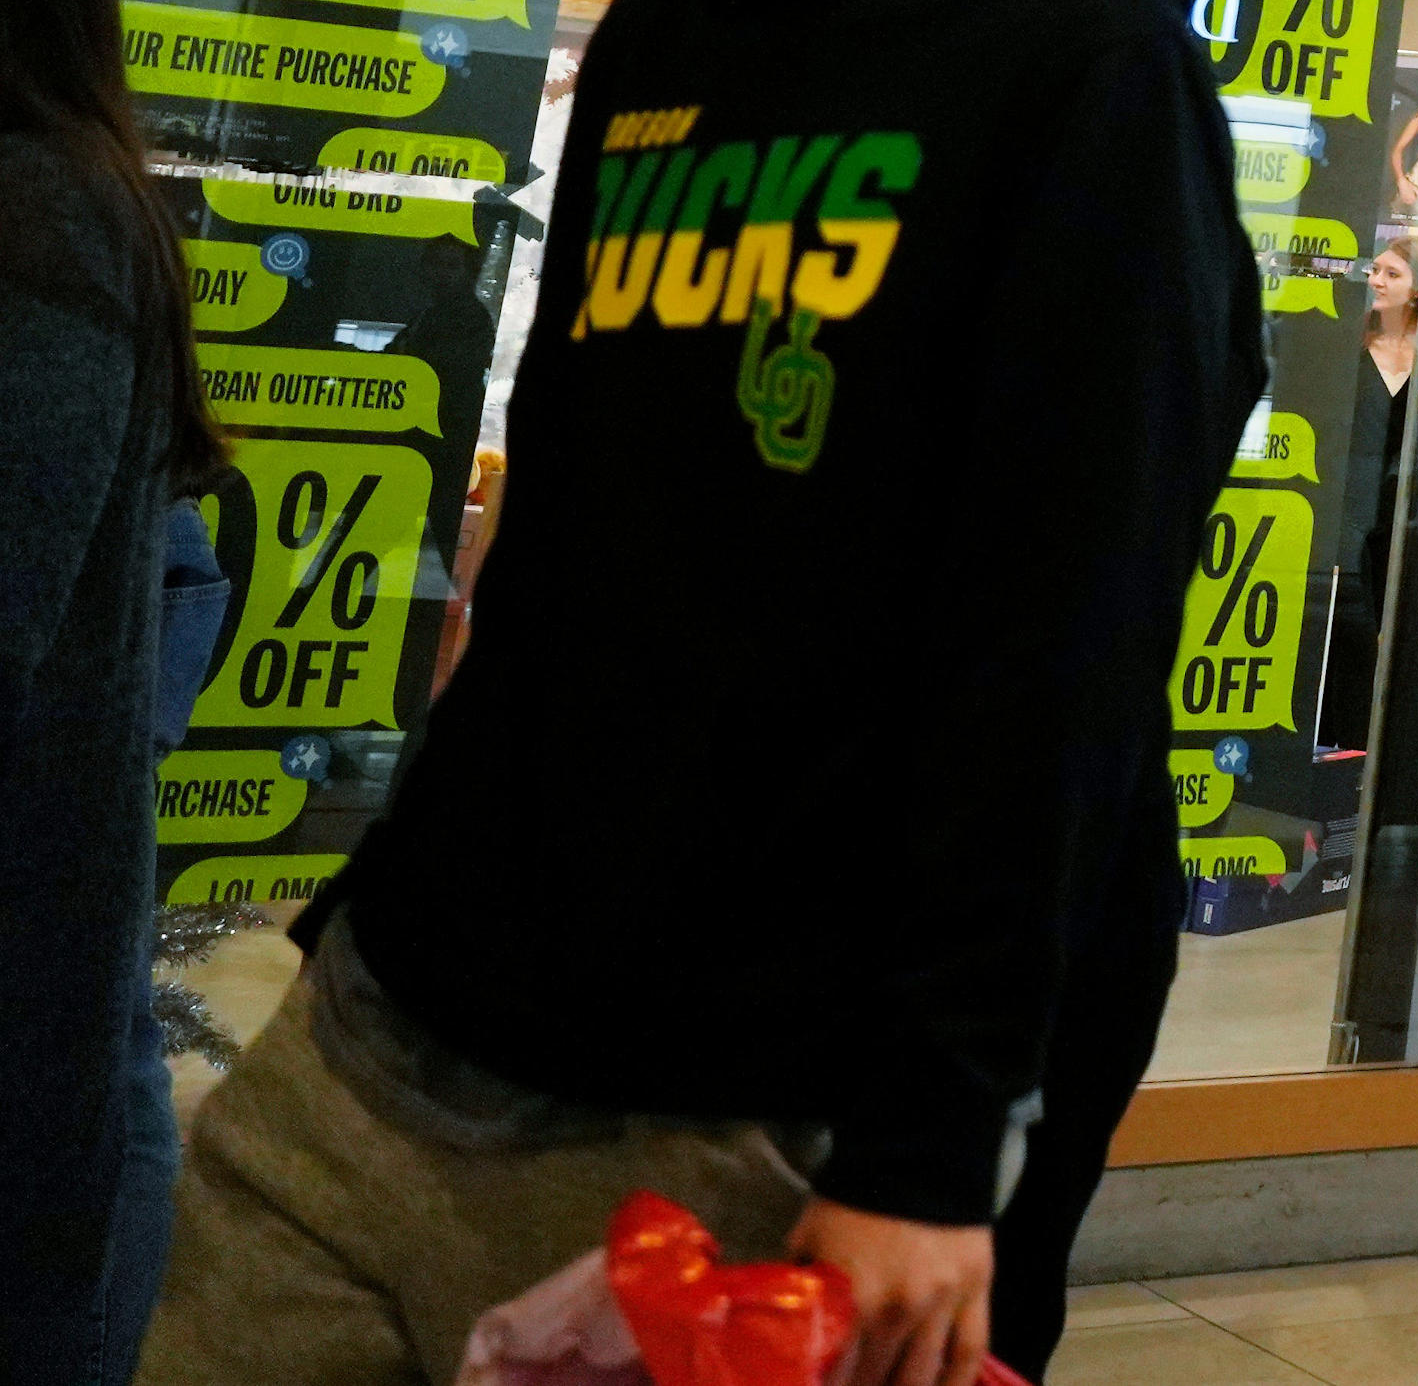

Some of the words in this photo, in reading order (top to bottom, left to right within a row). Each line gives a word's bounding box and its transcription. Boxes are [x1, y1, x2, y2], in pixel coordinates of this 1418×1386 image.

[170, 34, 267, 80] ENTIRE
[273, 52, 417, 95] PURCHASE
[1261, 39, 1349, 101] OFF
[570, 131, 923, 341] UCKS
[268, 371, 407, 410] OUTFITTERS
[239, 638, 370, 709] OFF
[1182, 655, 1273, 715] OFF
